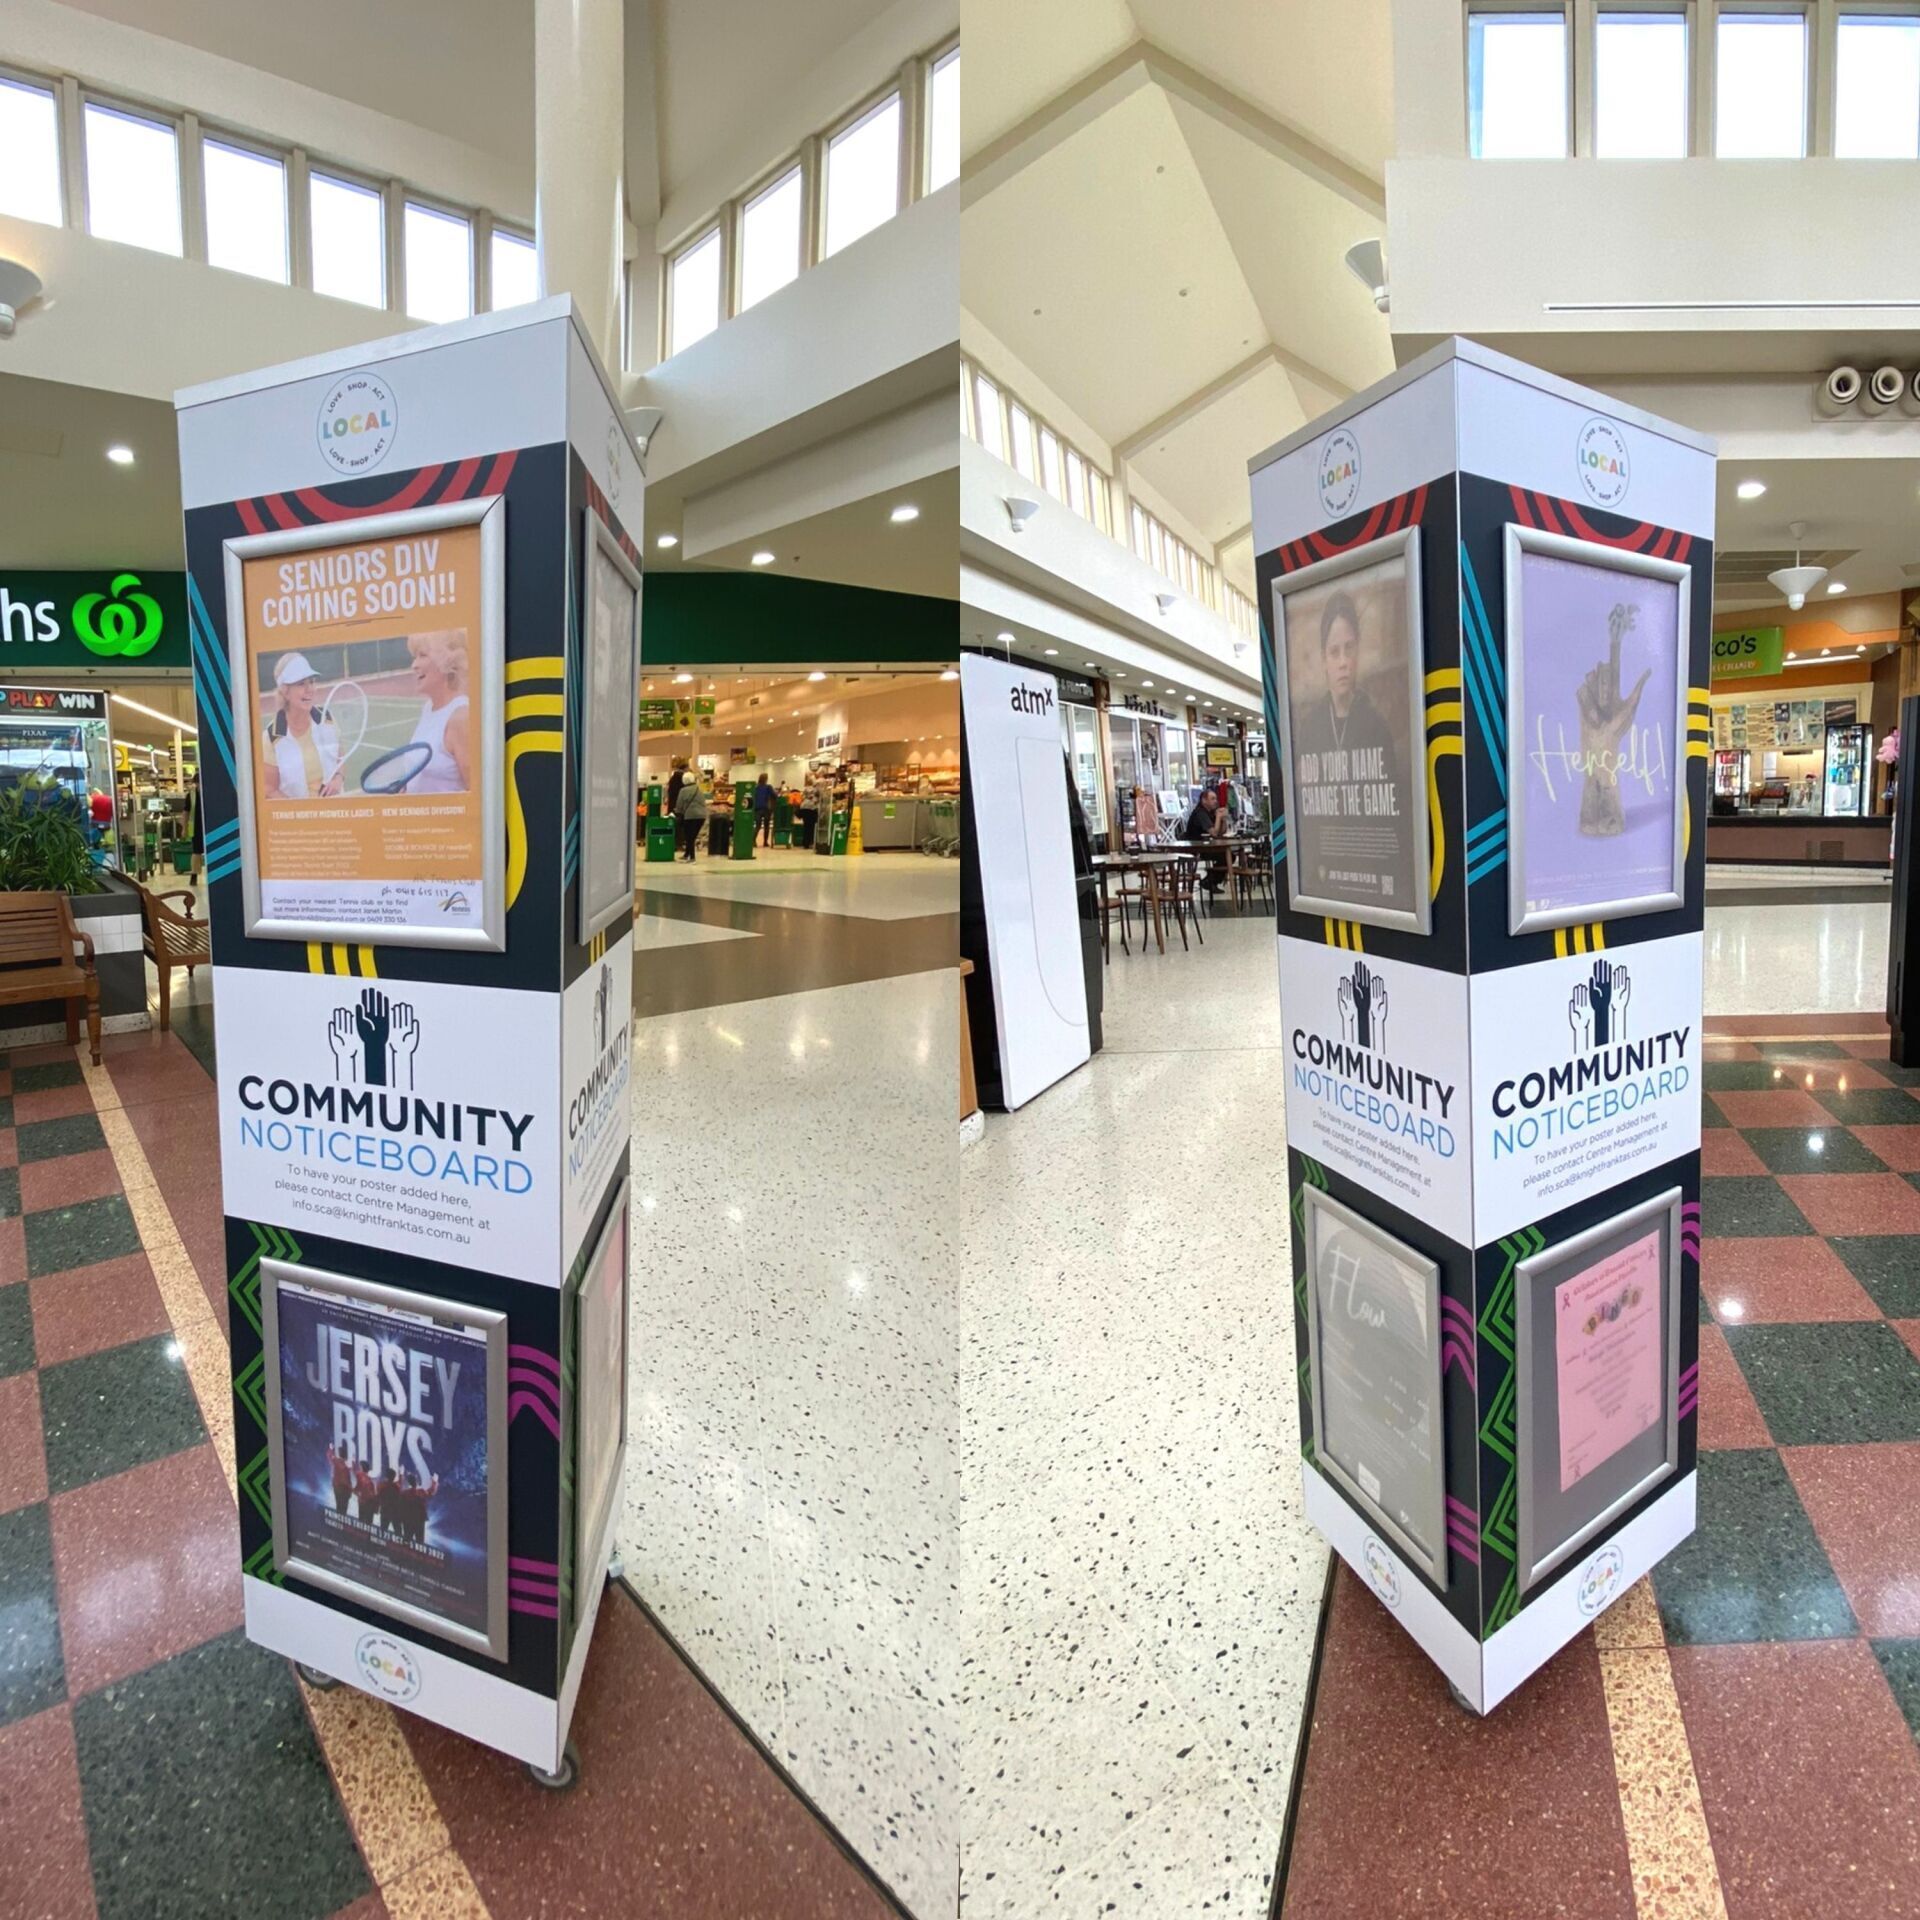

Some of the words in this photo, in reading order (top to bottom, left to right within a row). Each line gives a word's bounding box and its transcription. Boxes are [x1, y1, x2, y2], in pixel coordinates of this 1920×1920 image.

[322, 409, 391, 440] LOCAL
[1321, 459, 1357, 490] LOCAL
[1581, 448, 1626, 477] LOCAL
[278, 547, 387, 594] SENIORS
[394, 538, 440, 577] DIV
[262, 587, 357, 628] COMING
[364, 571, 456, 615] SOON!!
[1712, 634, 1757, 657] co's
[8, 690, 57, 709] PLAY
[58, 693, 95, 709] WIN
[22, 729, 48, 737] PIXAR
[1530, 714, 1669, 802] Herself!
[1301, 753, 1320, 784] ADD
[1322, 750, 1349, 782] YOUR
[1352, 747, 1388, 781] NAME.
[1301, 785, 1340, 816] CHANGE
[1341, 784, 1361, 816] THE
[1363, 783, 1400, 816] GAME.
[568, 1021, 630, 1141] COMMUNITY
[1292, 1028, 1455, 1119] COMMUNITY
[1492, 1026, 1690, 1118] COMMUNITY
[238, 1075, 535, 1152] COMMUNITY
[568, 1058, 630, 1184] NOTICEBOARD
[1294, 1063, 1455, 1158] NOTICEBOARD
[1493, 1065, 1690, 1160] NOTICEBOARD
[240, 1117, 533, 1194] NOTICEBOARD
[1357, 1125, 1379, 1144] poster
[1379, 1133, 1401, 1153] added
[1522, 1169, 1551, 1189] please
[1553, 1157, 1584, 1176] contact
[1586, 1145, 1612, 1162] Centre
[1613, 1125, 1660, 1151] Management
[1661, 1120, 1668, 1131] at
[1534, 1154, 1545, 1166] To
[1547, 1146, 1568, 1162] have
[1569, 1139, 1588, 1156] your
[1589, 1128, 1614, 1146] poster
[1616, 1118, 1640, 1135] added
[274, 1179, 309, 1195] please
[310, 1186, 352, 1203] contact
[355, 1193, 393, 1211] Centre
[396, 1201, 474, 1228] Management
[478, 1219, 490, 1231] at
[288, 1163, 301, 1176] To
[303, 1165, 330, 1181] have
[332, 1174, 357, 1193] your
[360, 1177, 396, 1194] poster
[400, 1184, 438, 1201] added
[441, 1191, 472, 1209] here,
[292, 1198, 471, 1245] info.sca@knightfranktas.com.au
[306, 1323, 461, 1430] JERSEY
[333, 1401, 434, 1490] BOYS
[360, 1650, 416, 1685] LOCAL
